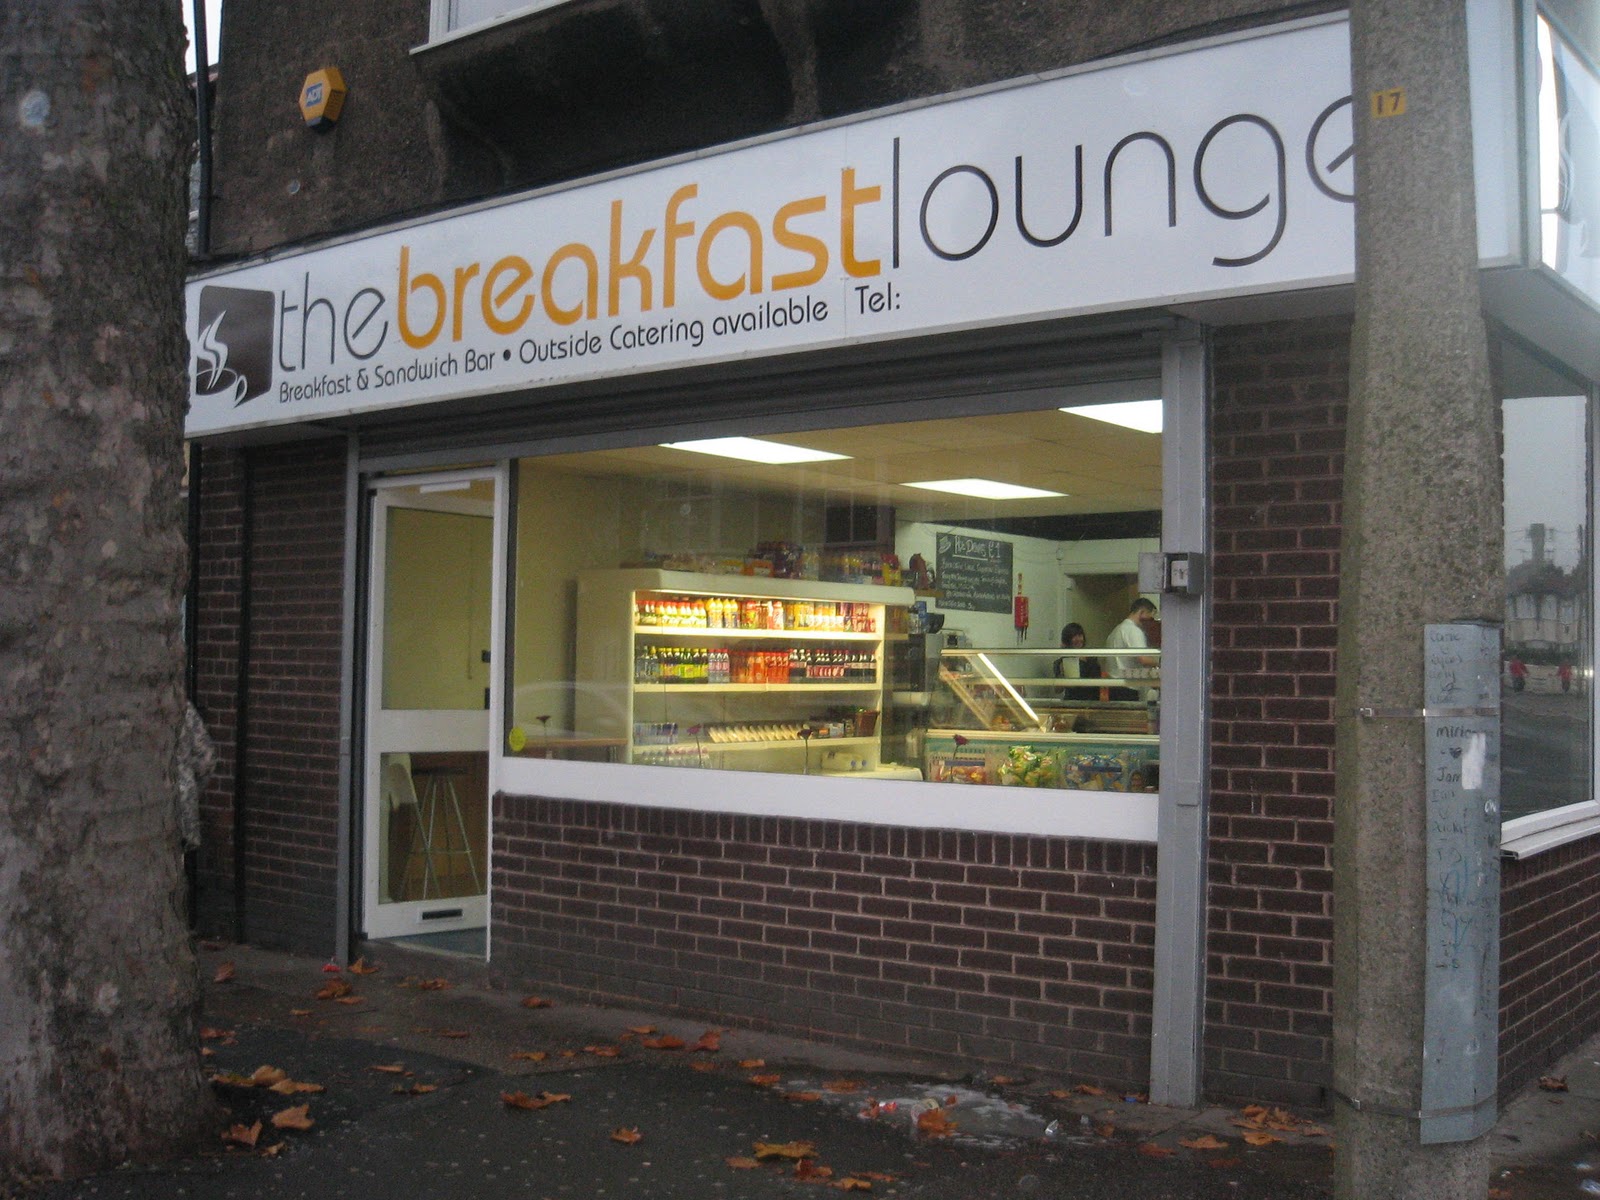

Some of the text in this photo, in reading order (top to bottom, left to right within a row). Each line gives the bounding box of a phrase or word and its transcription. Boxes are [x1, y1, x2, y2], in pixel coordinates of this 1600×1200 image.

[1377, 92, 1401, 115] 17
[278, 271, 389, 373] the
[397, 167, 882, 350] breakfast
[279, 281, 901, 403] Breakfast & Sandwich Bar Outside Catering available Tel:
